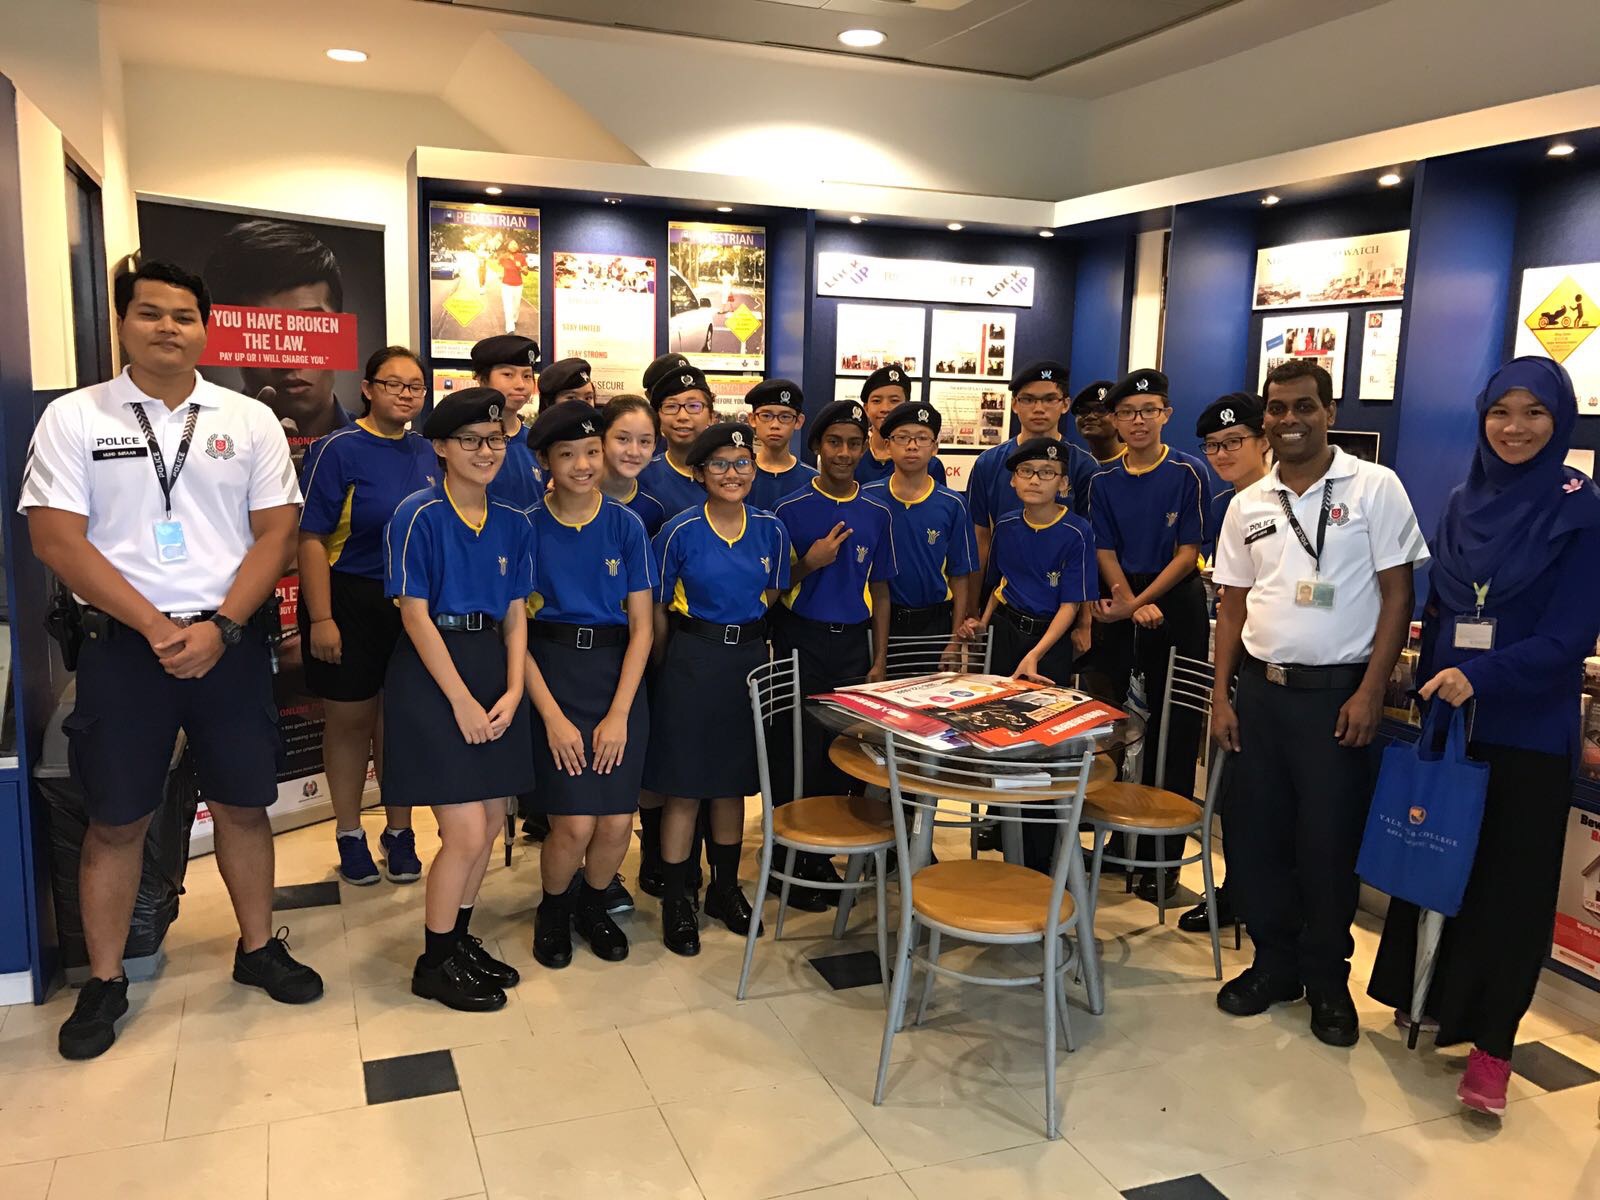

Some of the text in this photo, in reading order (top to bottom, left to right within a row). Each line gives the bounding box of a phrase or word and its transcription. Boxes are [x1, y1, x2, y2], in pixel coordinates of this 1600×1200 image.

[456, 211, 527, 228] PEDESTRIAN
[1344, 245, 1379, 256] WATCH
[1010, 276, 1028, 294] UP
[246, 312, 282, 331] HAVE
[287, 315, 339, 334] BROKEN
[243, 333, 307, 352] THE LAW.
[219, 351, 232, 361] PAY
[234, 352, 245, 362] UP
[246, 353, 257, 362] OR
[263, 354, 280, 363] WILL
[282, 355, 308, 364] CHARGE
[583, 350, 608, 359] STRONG
[597, 381, 625, 390] SECURE
[96, 437, 141, 447] POLICE
[152, 451, 165, 478] POLICE
[172, 451, 186, 478] POLICE
[1248, 518, 1276, 532] POLICE
[1294, 526, 1309, 547] POLICE
